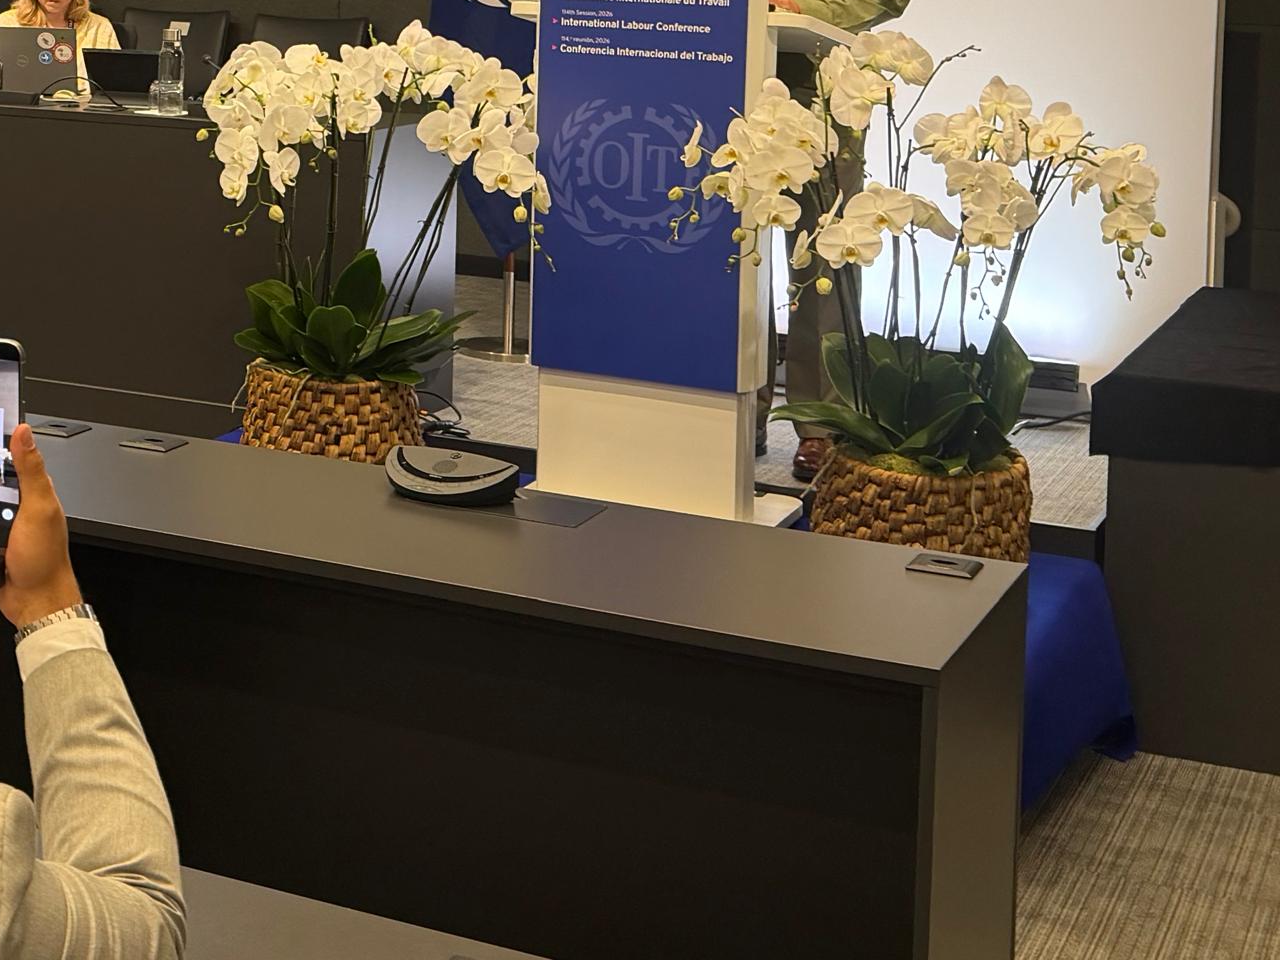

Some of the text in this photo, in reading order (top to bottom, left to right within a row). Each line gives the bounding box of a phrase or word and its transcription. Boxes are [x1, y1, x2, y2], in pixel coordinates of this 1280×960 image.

[560, 17, 711, 34] International Labour Conference
[560, 43, 733, 64] Conferencia Internacional del Trabajo
[593, 131, 679, 203] OIT
